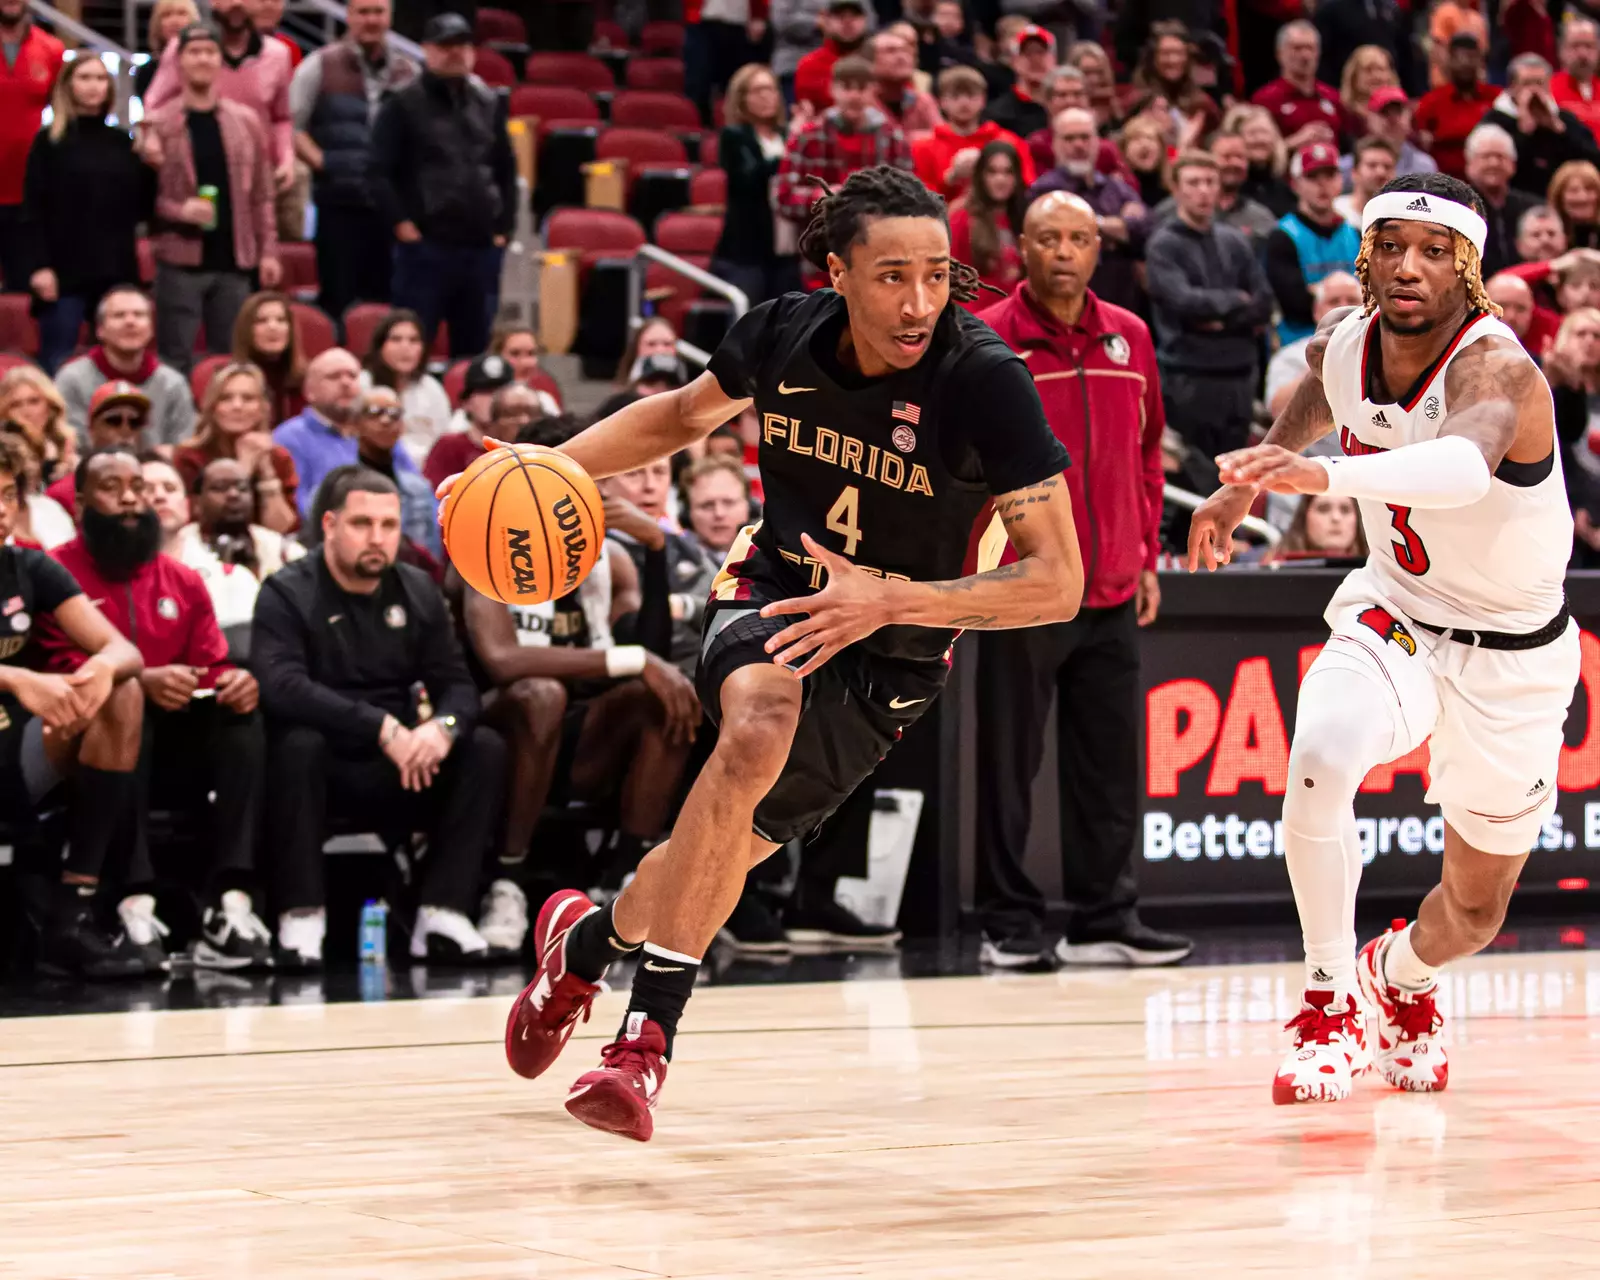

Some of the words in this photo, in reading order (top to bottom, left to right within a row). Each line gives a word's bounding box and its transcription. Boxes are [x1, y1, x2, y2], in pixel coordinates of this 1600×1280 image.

[1406, 205, 1431, 213] adidas
[763, 412, 934, 497] FLORIDA
[1372, 420, 1392, 429] adidas
[552, 493, 587, 591] Wilson
[826, 485, 863, 557] 4
[1384, 502, 1431, 577] 3
[507, 527, 538, 595] NCAA
